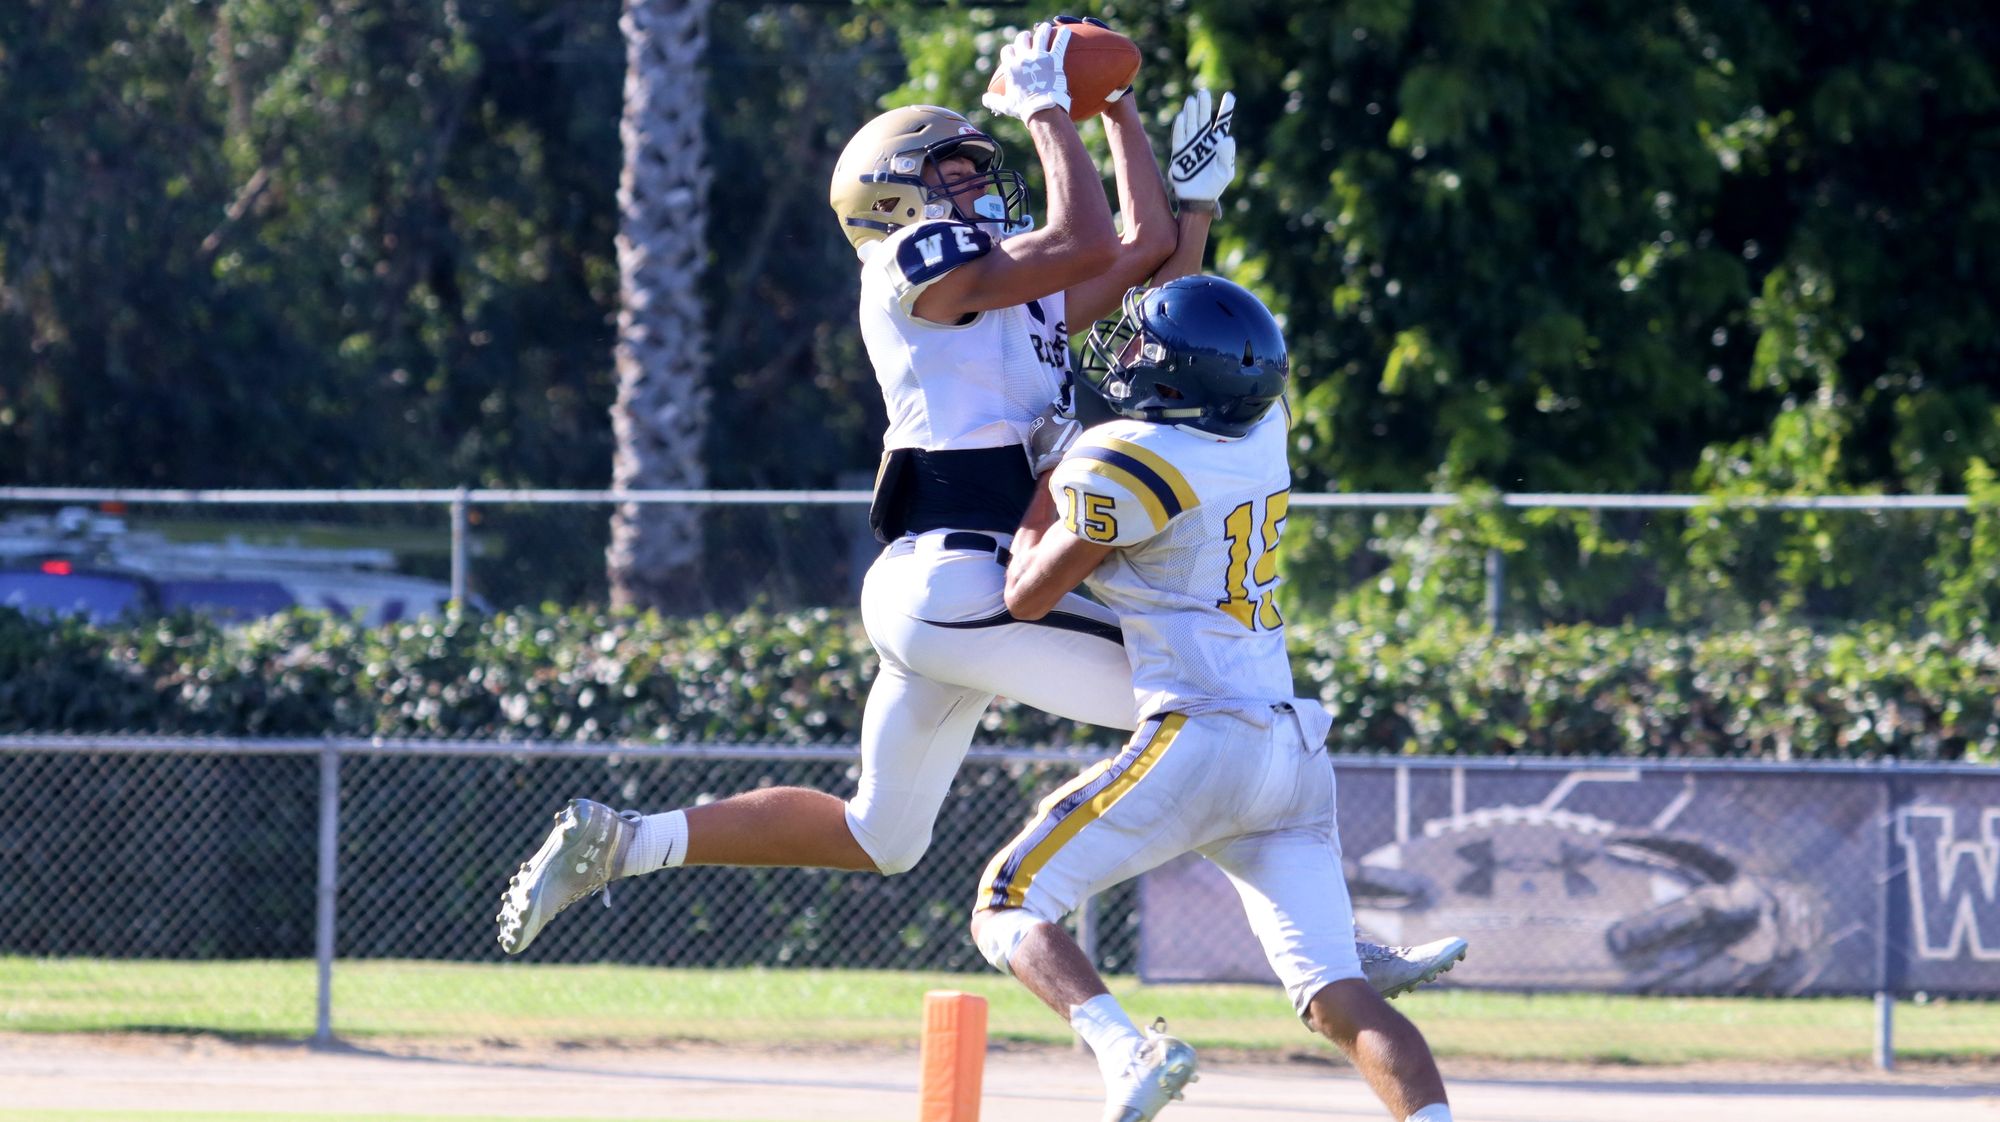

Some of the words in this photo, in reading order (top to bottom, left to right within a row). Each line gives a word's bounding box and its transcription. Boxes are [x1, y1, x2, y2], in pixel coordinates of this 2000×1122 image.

[1176, 121, 1230, 174] BATT
[914, 226, 980, 267] WE
[1063, 485, 1118, 543] 15
[1216, 487, 1292, 632] 15
